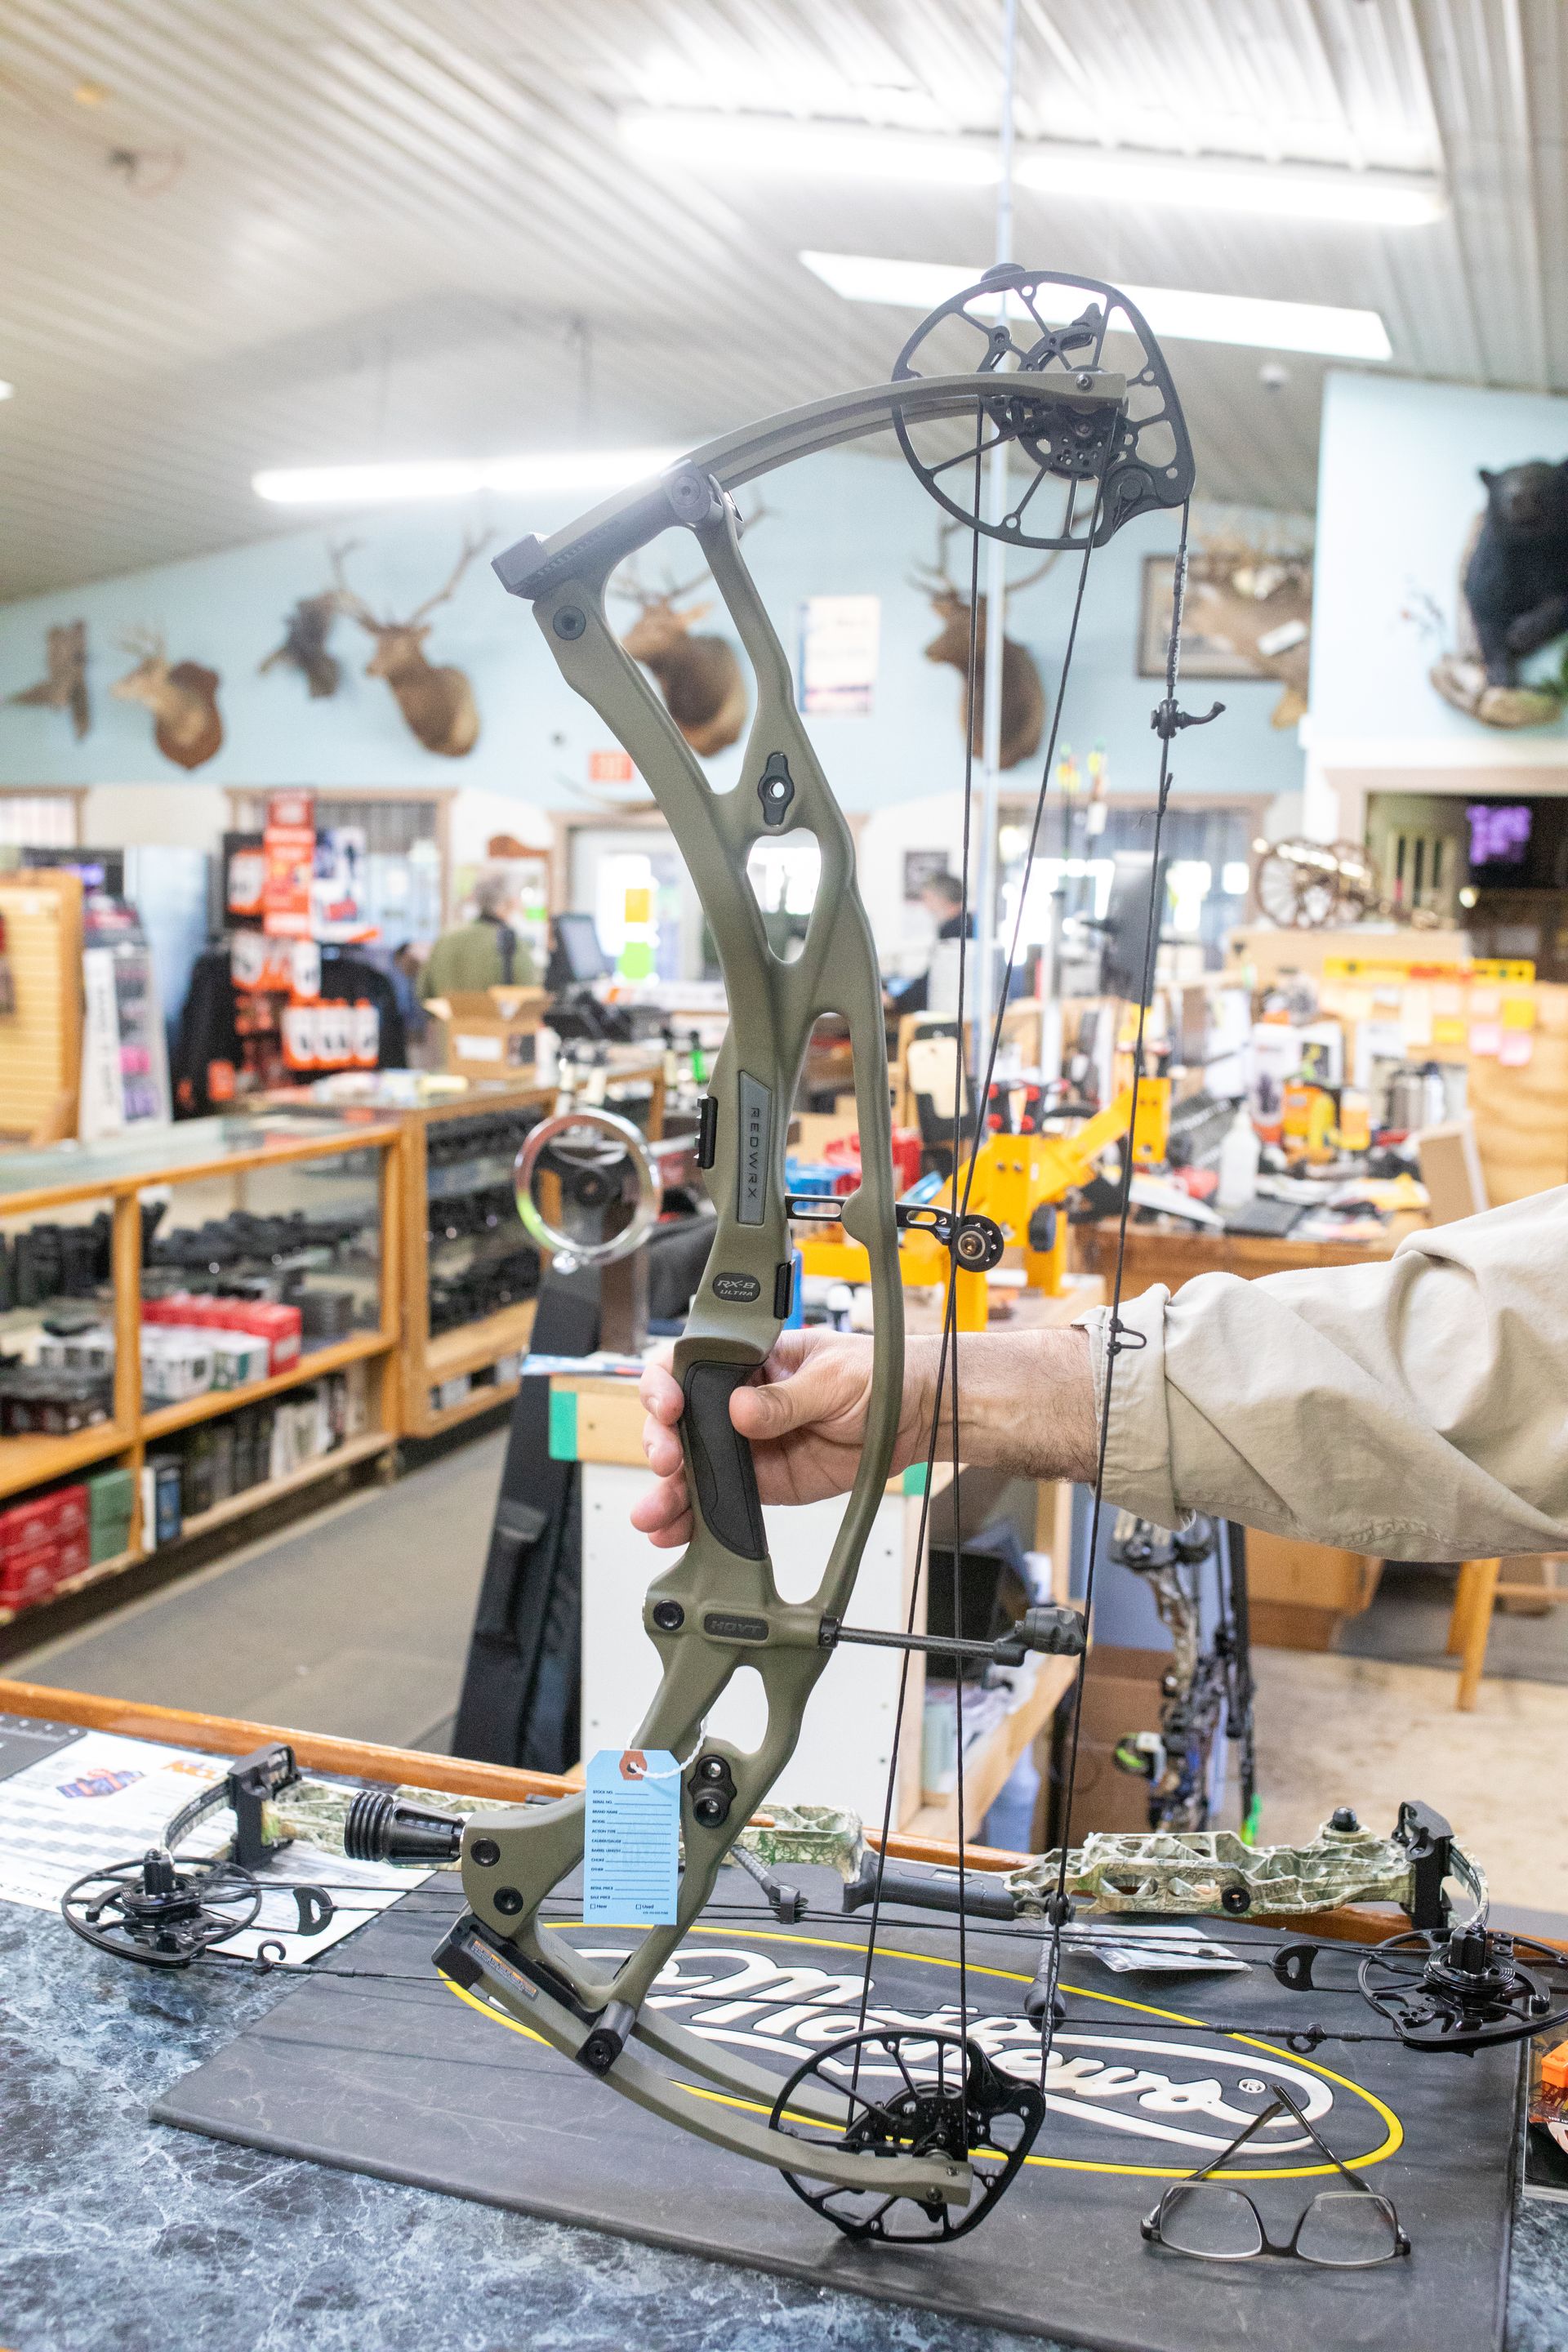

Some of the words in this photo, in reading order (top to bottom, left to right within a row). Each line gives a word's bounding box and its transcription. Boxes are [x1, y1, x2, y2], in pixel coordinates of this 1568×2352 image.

[747, 1107, 760, 1199] REDWRX
[717, 1279, 756, 1290] RX-8
[719, 1289, 753, 1297] ULTRA
[710, 1620, 761, 1633] HOYT
